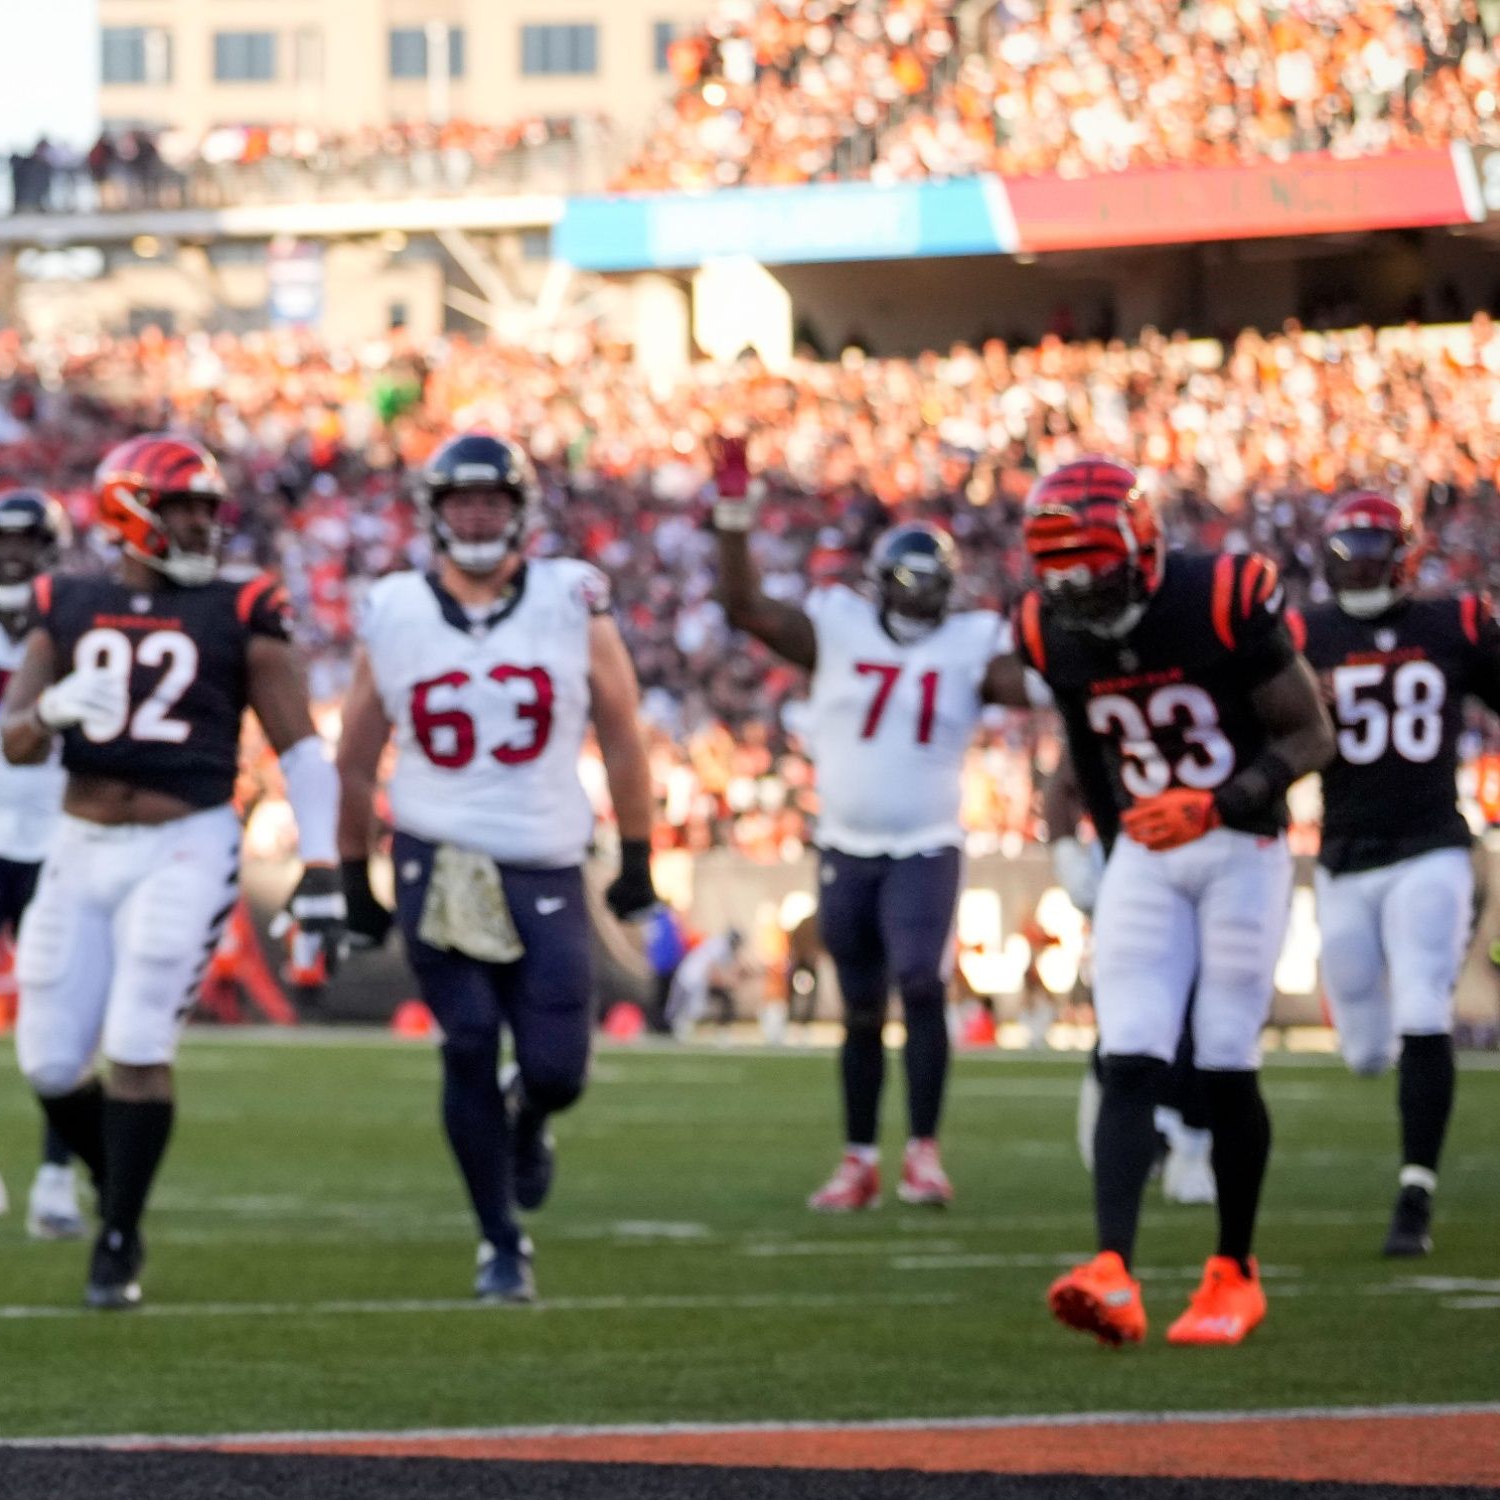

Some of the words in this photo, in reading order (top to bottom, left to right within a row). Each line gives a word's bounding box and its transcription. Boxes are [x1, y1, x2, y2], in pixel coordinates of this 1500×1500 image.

[74, 627, 199, 743] 92
[411, 665, 554, 768] 63
[855, 661, 940, 744] 71
[1333, 660, 1446, 765] 58
[1087, 684, 1235, 798] 33
